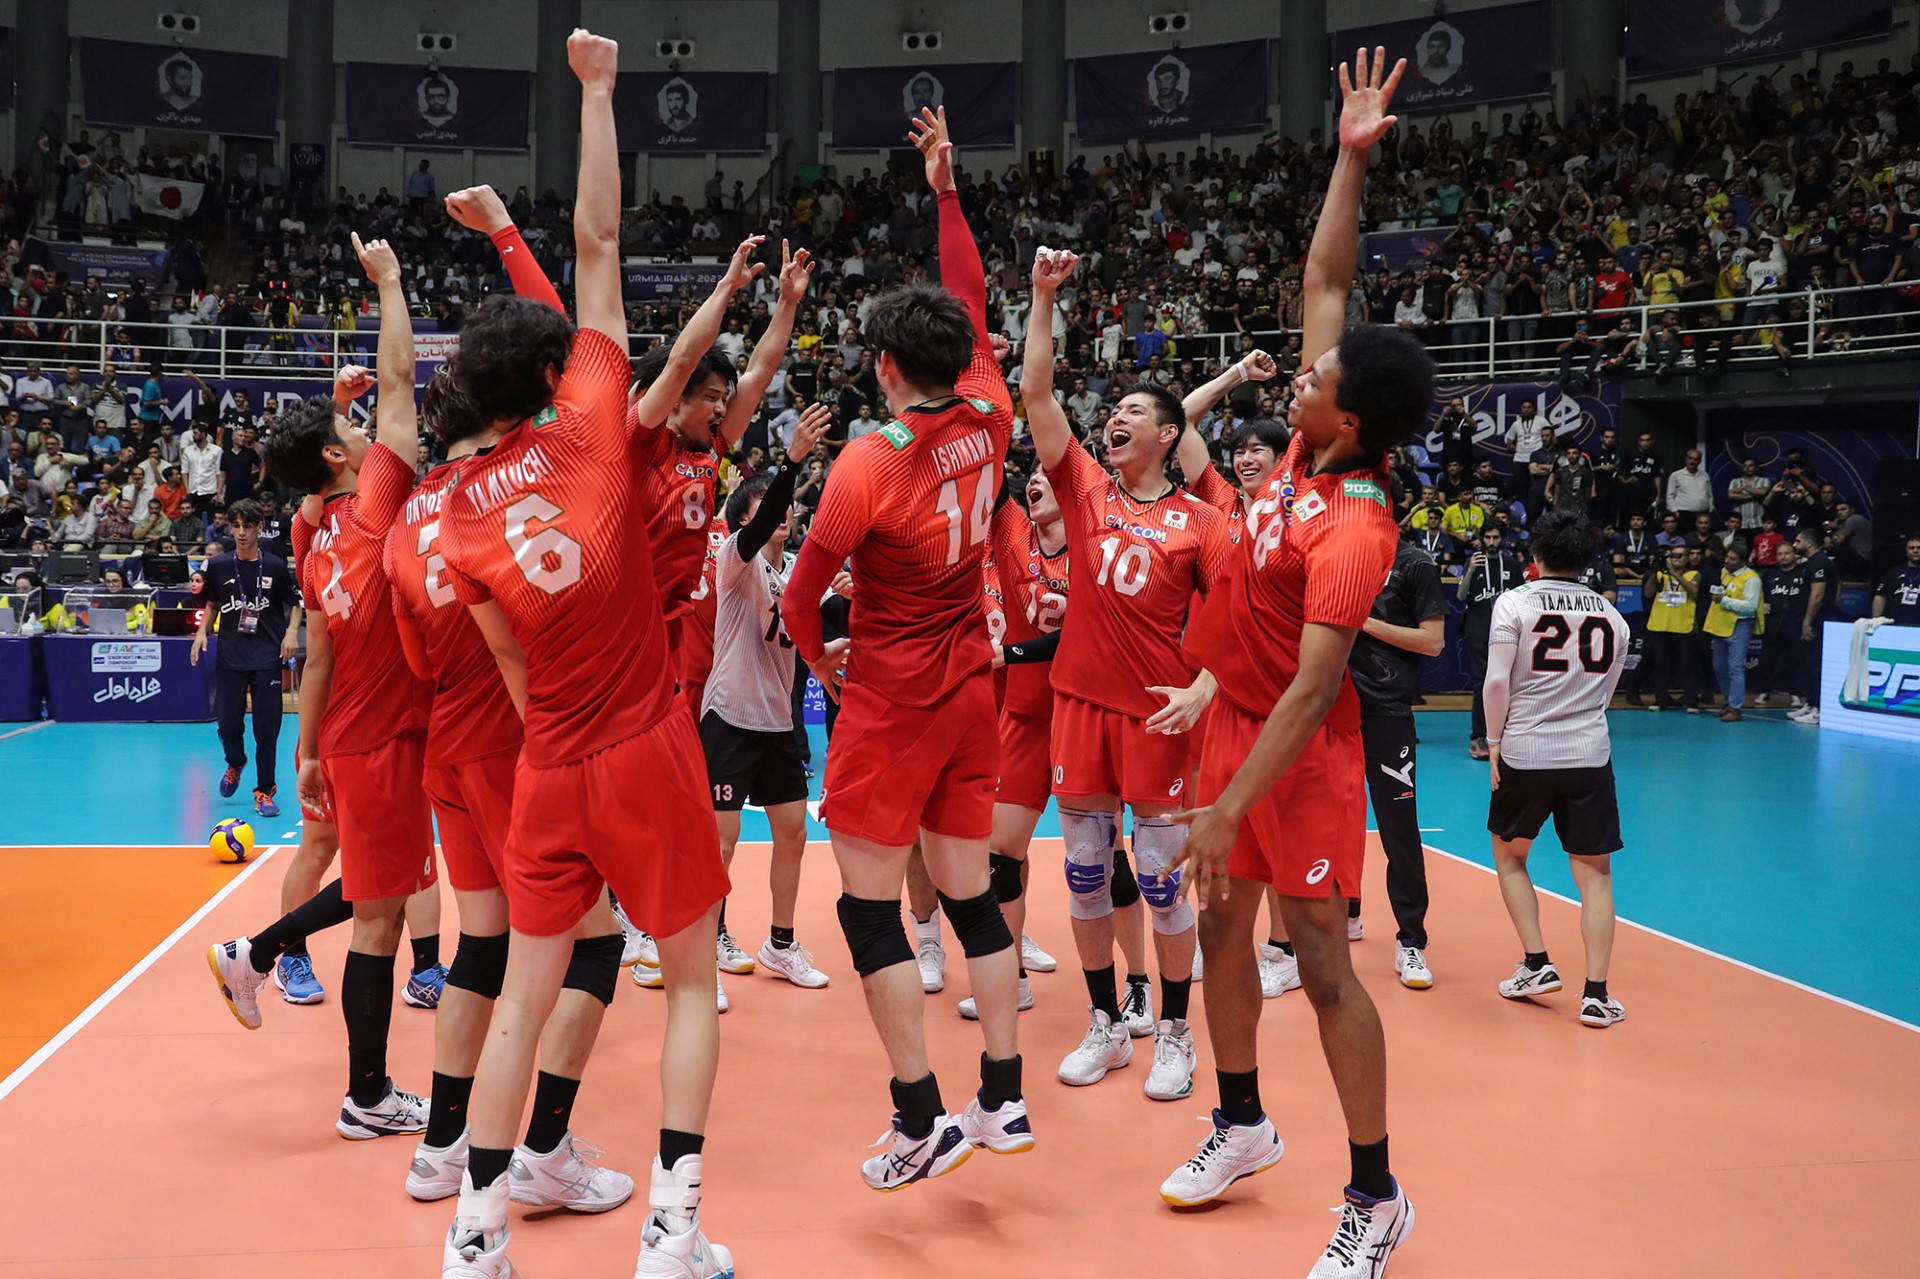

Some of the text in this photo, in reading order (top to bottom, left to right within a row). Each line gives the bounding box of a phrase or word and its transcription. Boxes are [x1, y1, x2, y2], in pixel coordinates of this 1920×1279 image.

[1724, 31, 1783, 54] کریم بهرامی
[1455, 83, 1474, 97] علی
[674, 462, 714, 479] CAPC
[931, 428, 995, 479] ISHIKAWA
[465, 443, 555, 516] YAMAUCHI
[682, 482, 706, 530] 8
[935, 461, 995, 566] 14
[1104, 514, 1168, 544] CAPCOM
[416, 519, 460, 609] 2
[505, 492, 582, 595] 6
[1096, 535, 1153, 597] 10
[321, 549, 354, 621] 4
[1026, 582, 1068, 634] 12
[1539, 594, 1605, 612] YAMAMOTO
[1531, 614, 1615, 674] 20
[713, 783, 733, 802] 13
